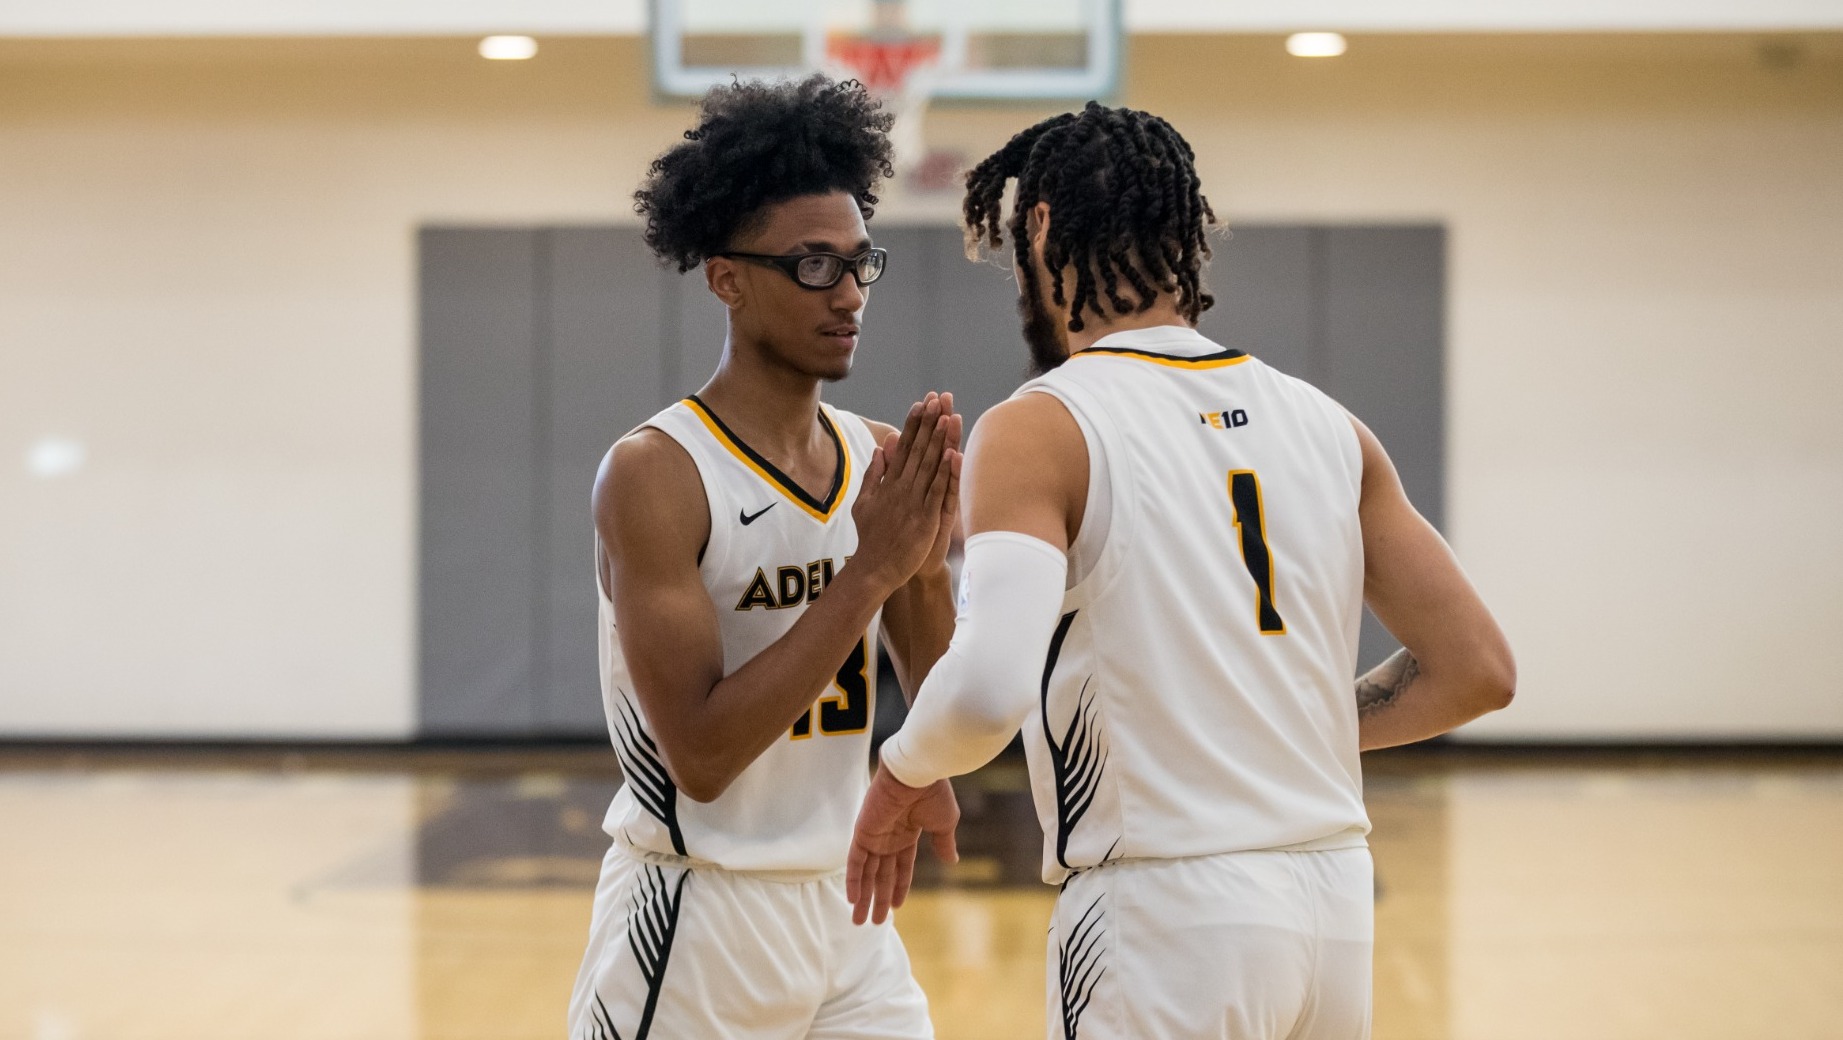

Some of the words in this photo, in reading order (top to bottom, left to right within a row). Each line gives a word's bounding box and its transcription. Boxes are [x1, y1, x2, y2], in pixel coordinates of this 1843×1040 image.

[735, 556, 853, 611] ADEL
[1227, 469, 1287, 635] 1
[789, 628, 869, 740] 3
